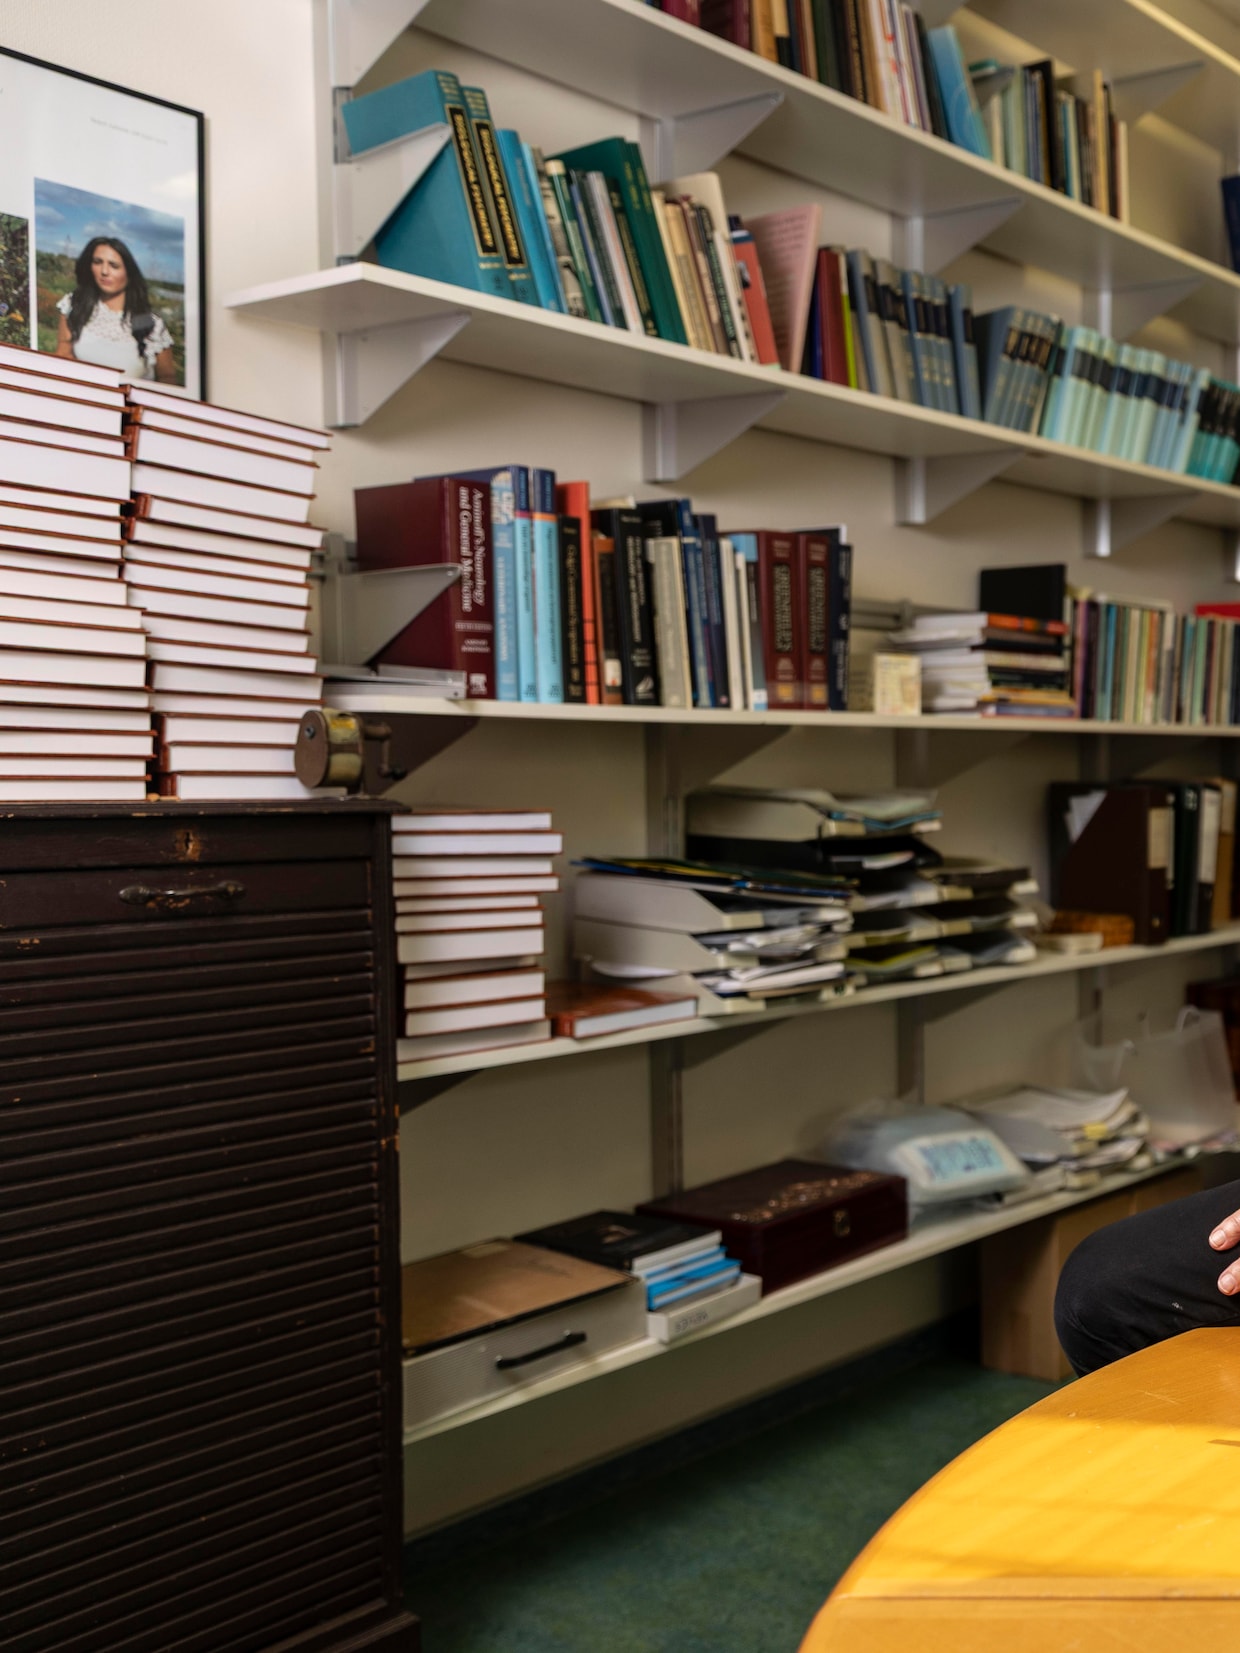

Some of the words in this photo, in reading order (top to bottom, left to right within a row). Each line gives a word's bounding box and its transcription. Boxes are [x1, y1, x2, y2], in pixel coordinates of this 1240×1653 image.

[453, 113, 476, 183] BIOLOGICAL
[471, 183, 494, 248] PSYCHIATRY
[480, 128, 503, 195] BIOLOGICAL
[498, 197, 520, 259] PSYCHIATRY
[459, 486, 471, 509] and
[473, 487, 485, 546] Aminoff's
[459, 510, 473, 557] General
[461, 558, 473, 613] Medicine
[474, 546, 487, 606] Neurology
